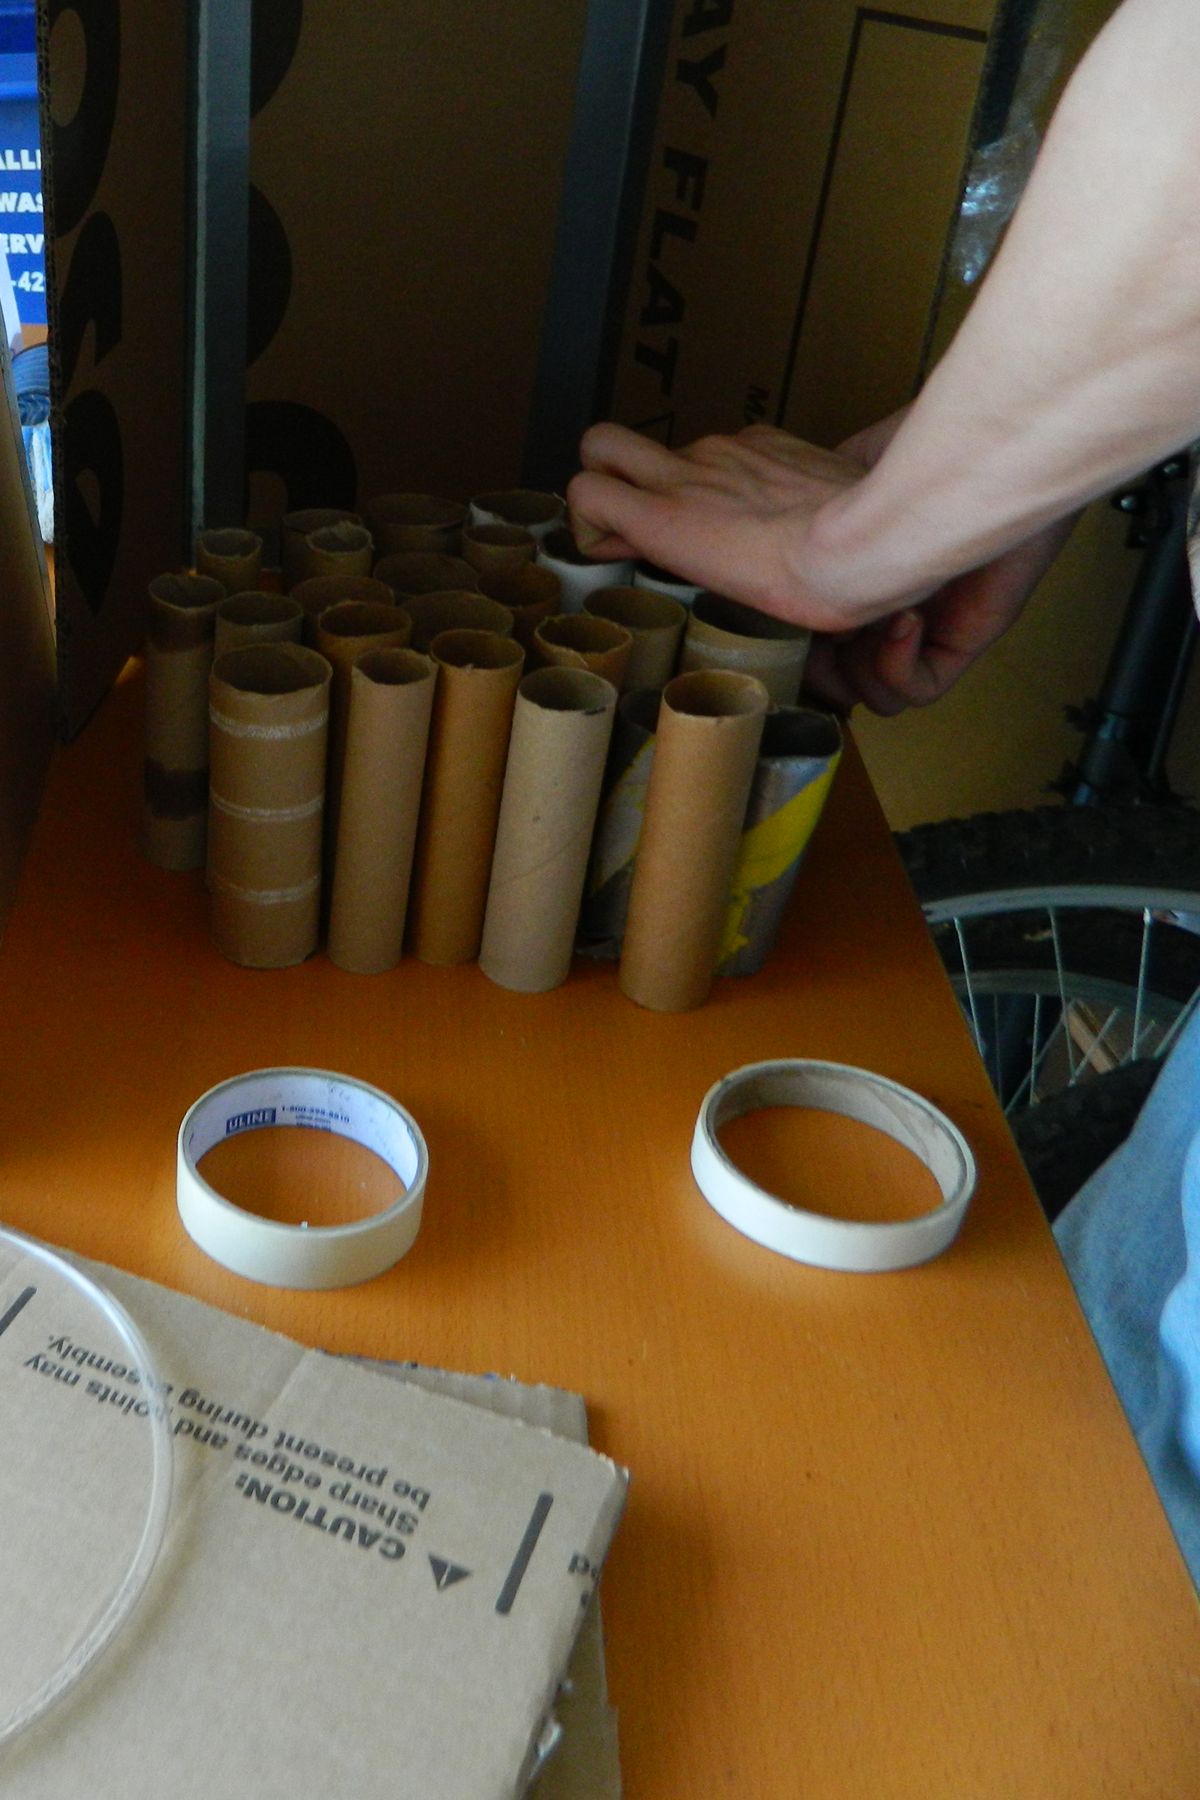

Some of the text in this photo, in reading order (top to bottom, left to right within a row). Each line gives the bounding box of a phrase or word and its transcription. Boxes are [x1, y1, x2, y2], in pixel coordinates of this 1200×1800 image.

[634, 146, 708, 396] FLAT
[227, 1108, 276, 1134] ULINE
[23, 1351, 419, 1536] Sharp edges and oints may
[46, 1333, 432, 1512] be present during sembly.
[234, 1471, 407, 1561] CAUTION:
